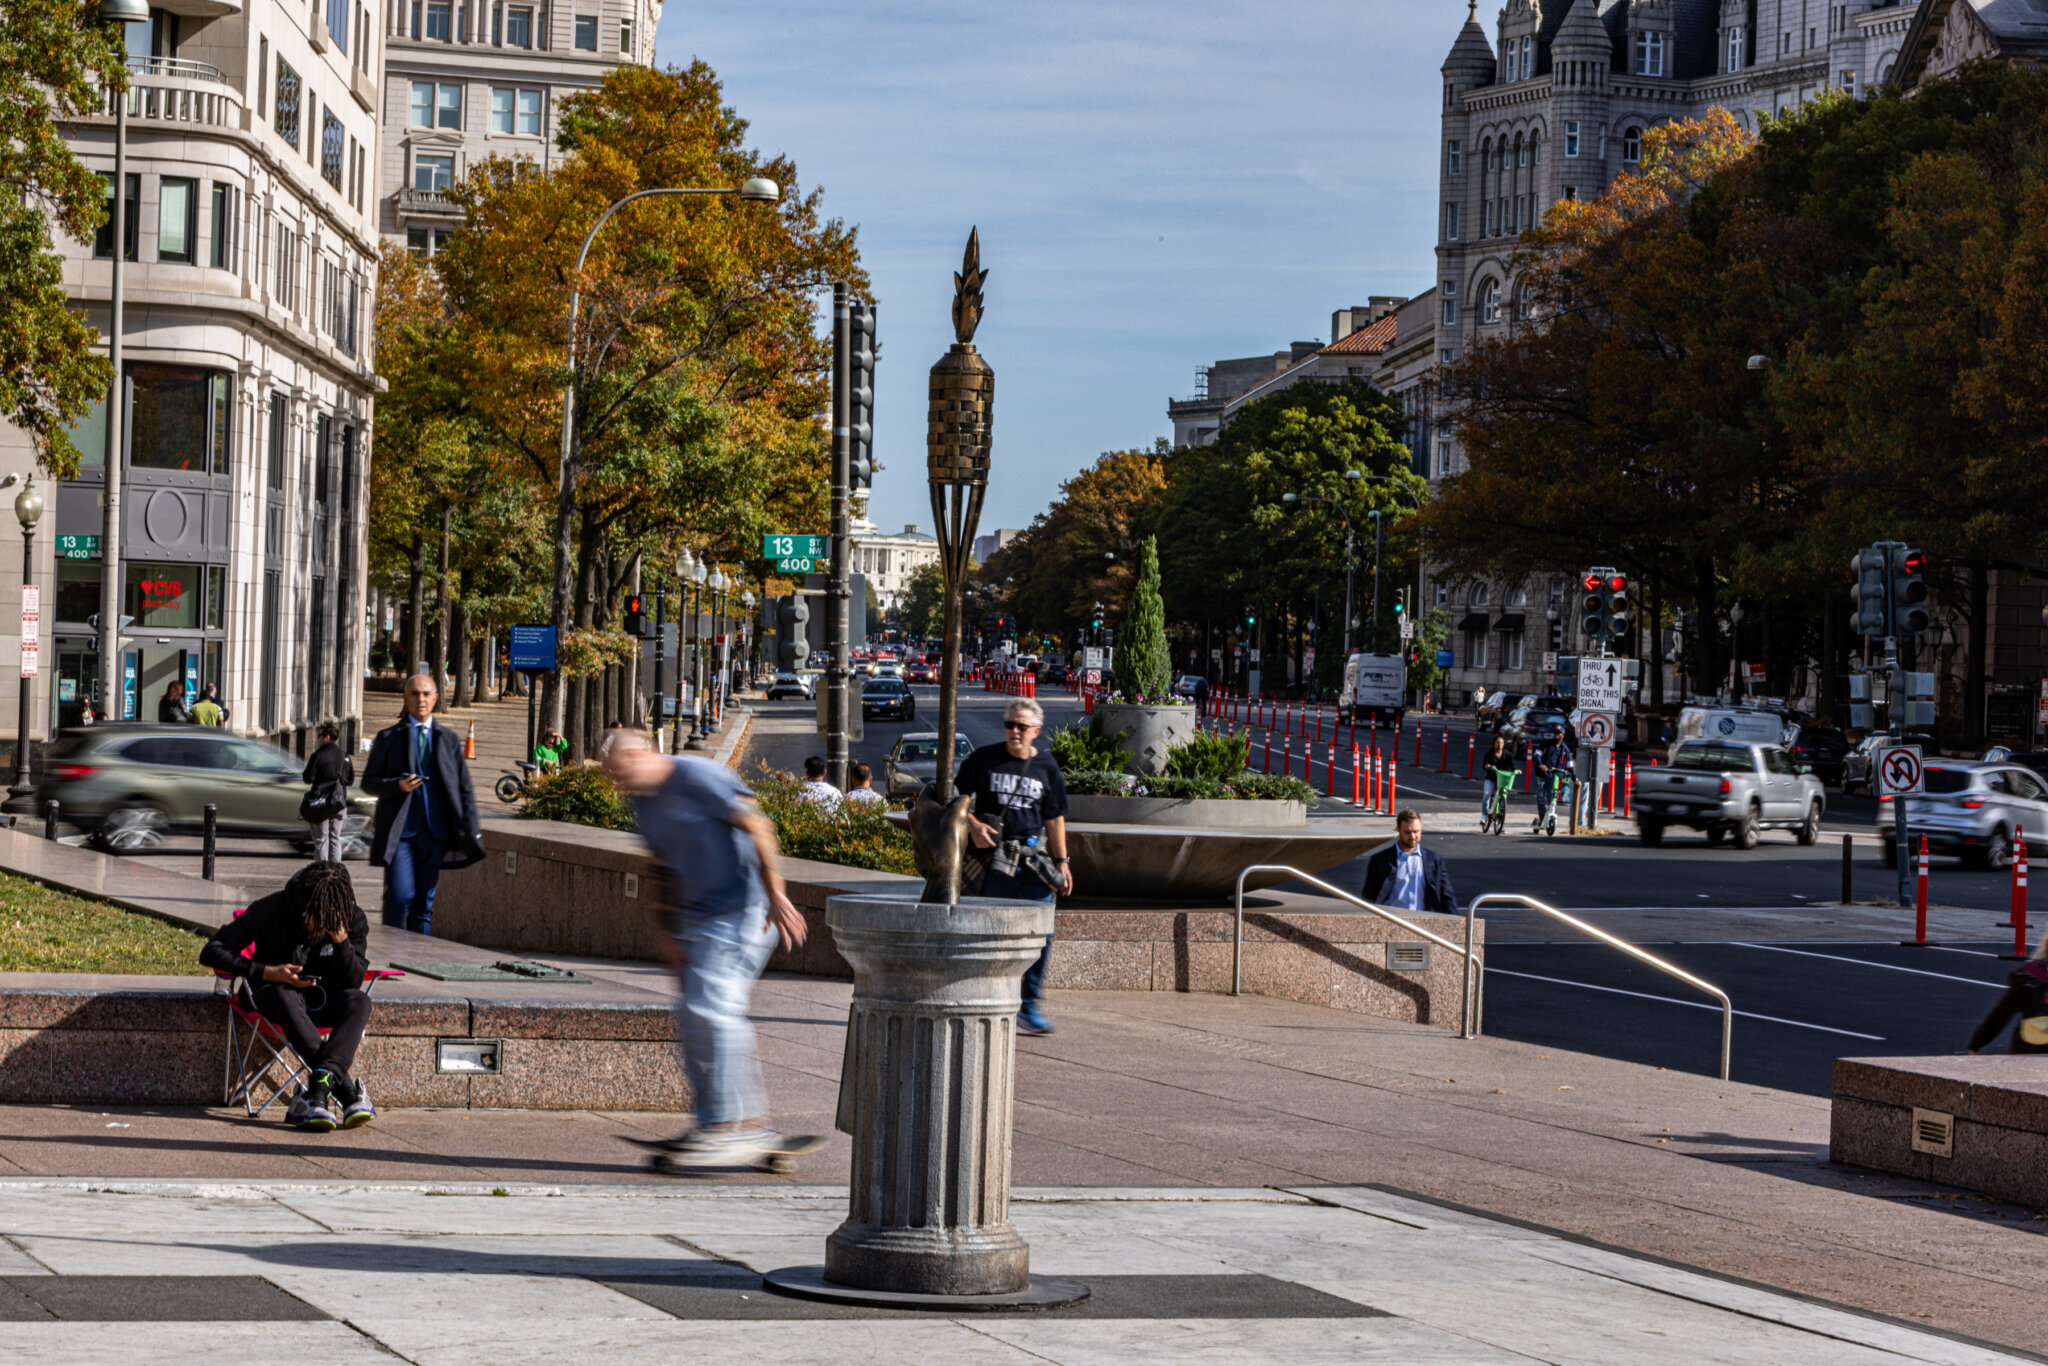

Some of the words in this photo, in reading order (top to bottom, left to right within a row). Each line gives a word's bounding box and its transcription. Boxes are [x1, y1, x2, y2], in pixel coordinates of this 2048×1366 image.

[62, 536, 76, 548] 13
[773, 537, 794, 555] 13
[809, 538, 821, 547] ST
[67, 549, 88, 558] 400
[809, 547, 822, 555] NW
[781, 558, 810, 570] 400
[154, 580, 182, 597] CVS
[142, 598, 180, 611] pharmacy
[1583, 662, 1602, 671] THRU
[1580, 689, 1600, 698] OBEY
[1603, 690, 1619, 699] THIS
[1580, 699, 1606, 708] SIGNAL
